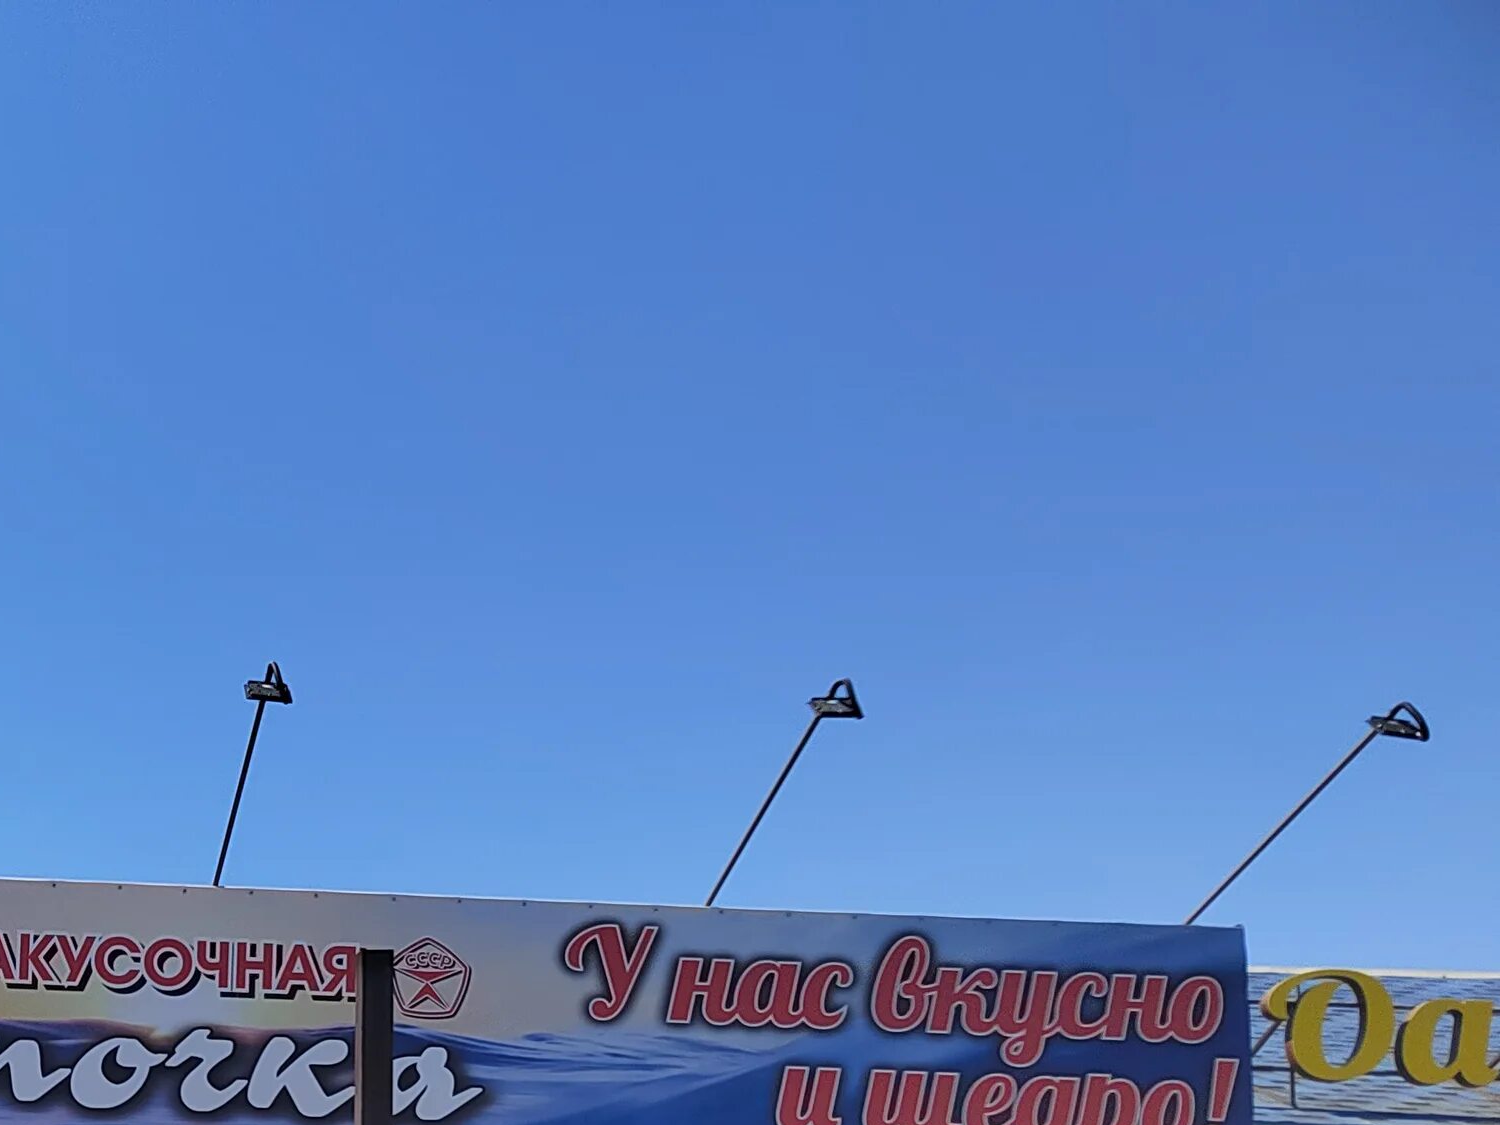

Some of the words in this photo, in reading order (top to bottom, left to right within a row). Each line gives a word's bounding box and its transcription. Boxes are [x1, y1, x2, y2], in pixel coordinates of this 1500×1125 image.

[404, 951, 455, 969] СССР
[564, 923, 659, 1021] У
[665, 956, 854, 1030] нас
[870, 935, 1224, 1068] вкусно
